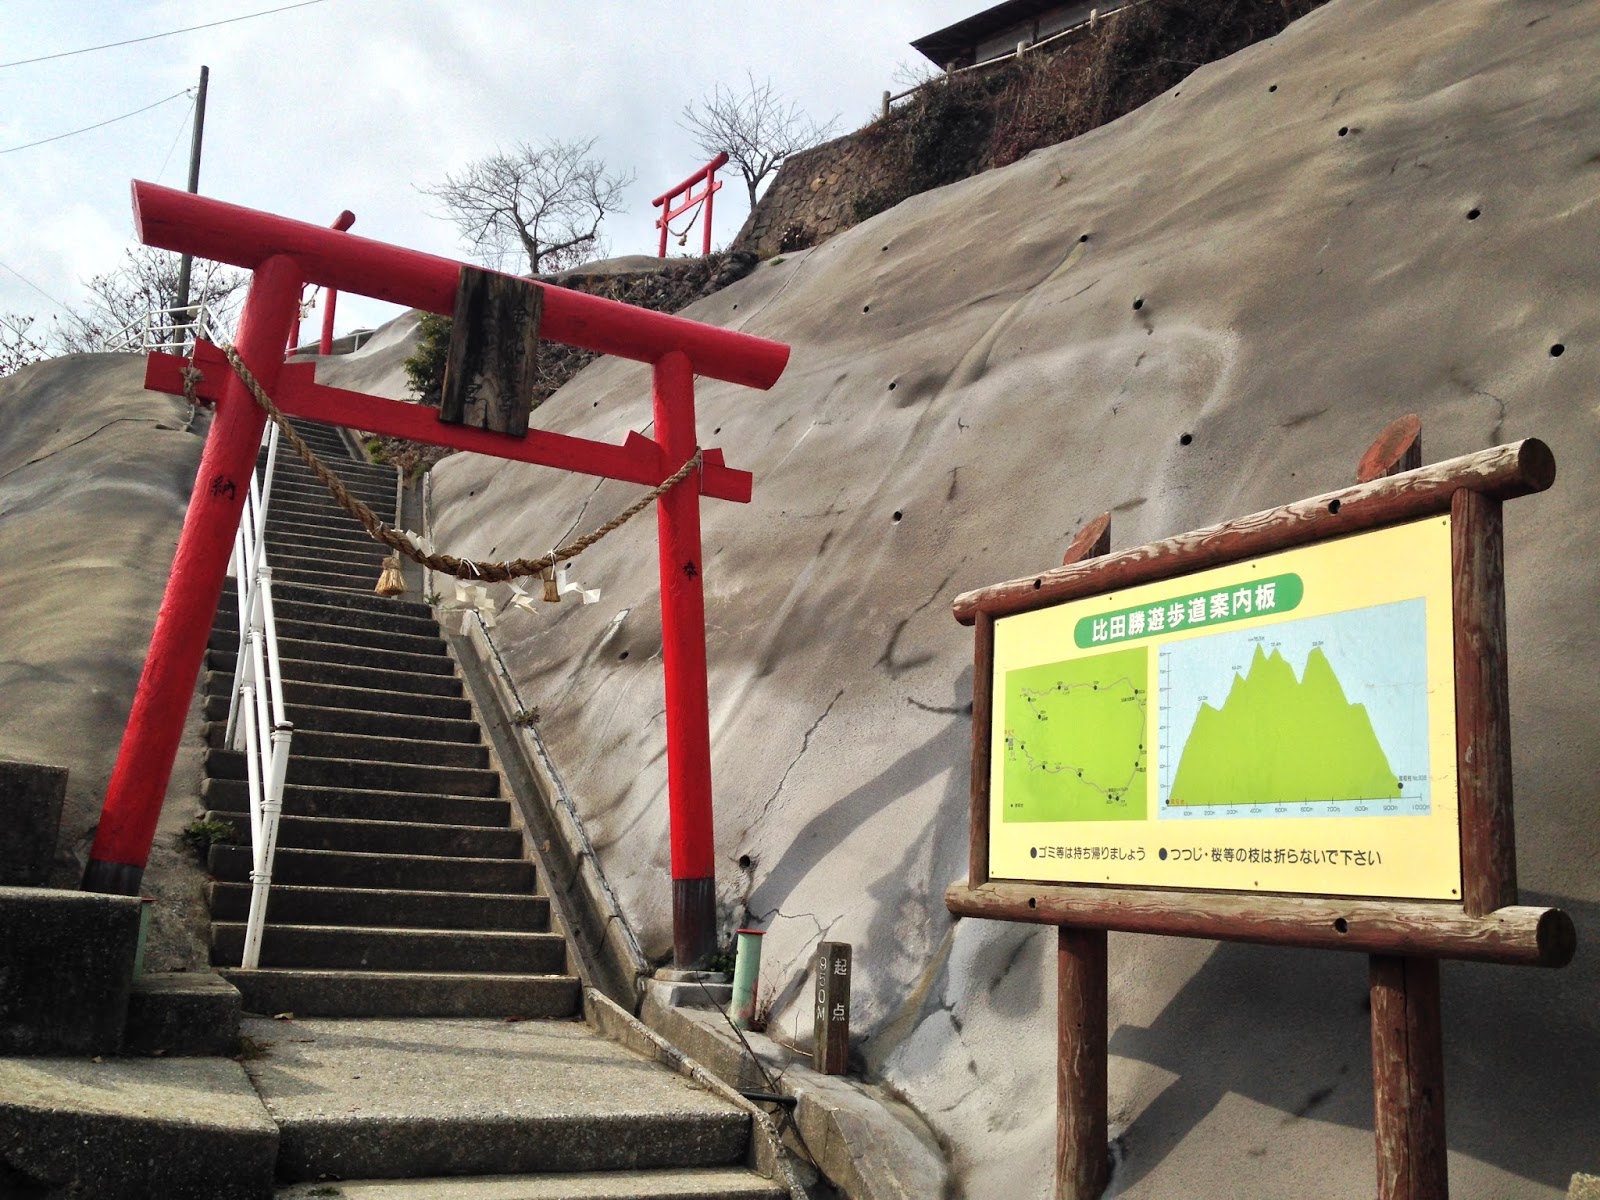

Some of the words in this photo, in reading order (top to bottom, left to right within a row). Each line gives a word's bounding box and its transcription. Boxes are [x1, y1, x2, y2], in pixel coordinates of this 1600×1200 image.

[212, 475, 236, 501] 納
[1092, 582, 1276, 642] 比田勝遊歩道案内板
[832, 957, 847, 1021] 起点
